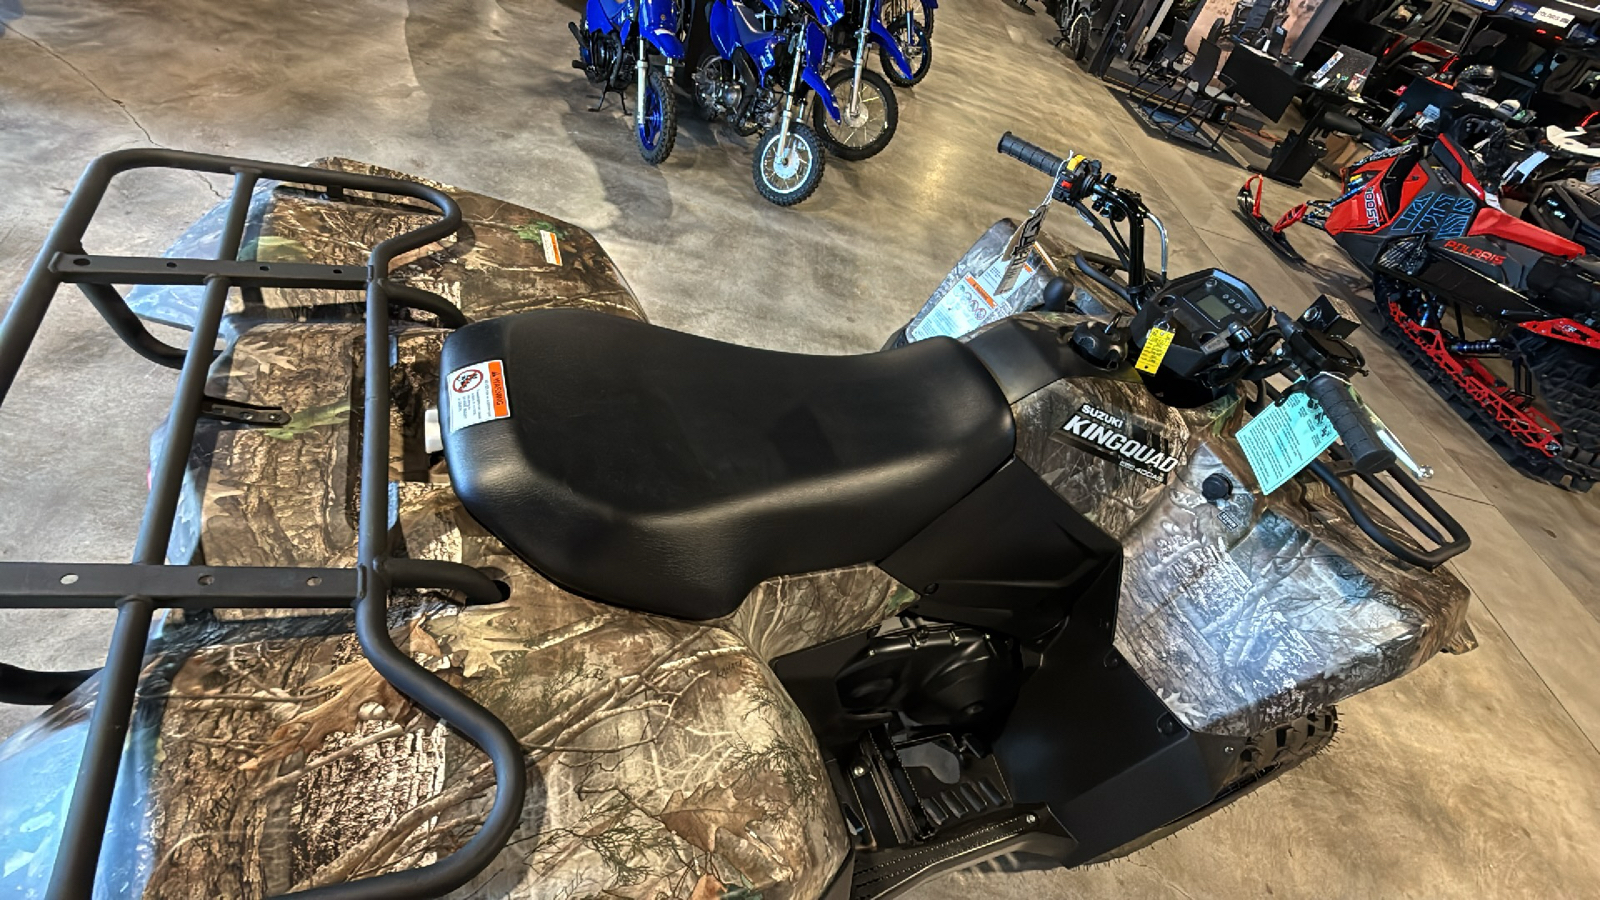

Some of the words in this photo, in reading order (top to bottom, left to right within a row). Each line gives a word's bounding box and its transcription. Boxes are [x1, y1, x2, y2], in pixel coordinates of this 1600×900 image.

[1444, 240, 1507, 265] POLARIS
[1081, 405, 1123, 428] SUZUKI
[1063, 415, 1178, 472] KINGQUAD
